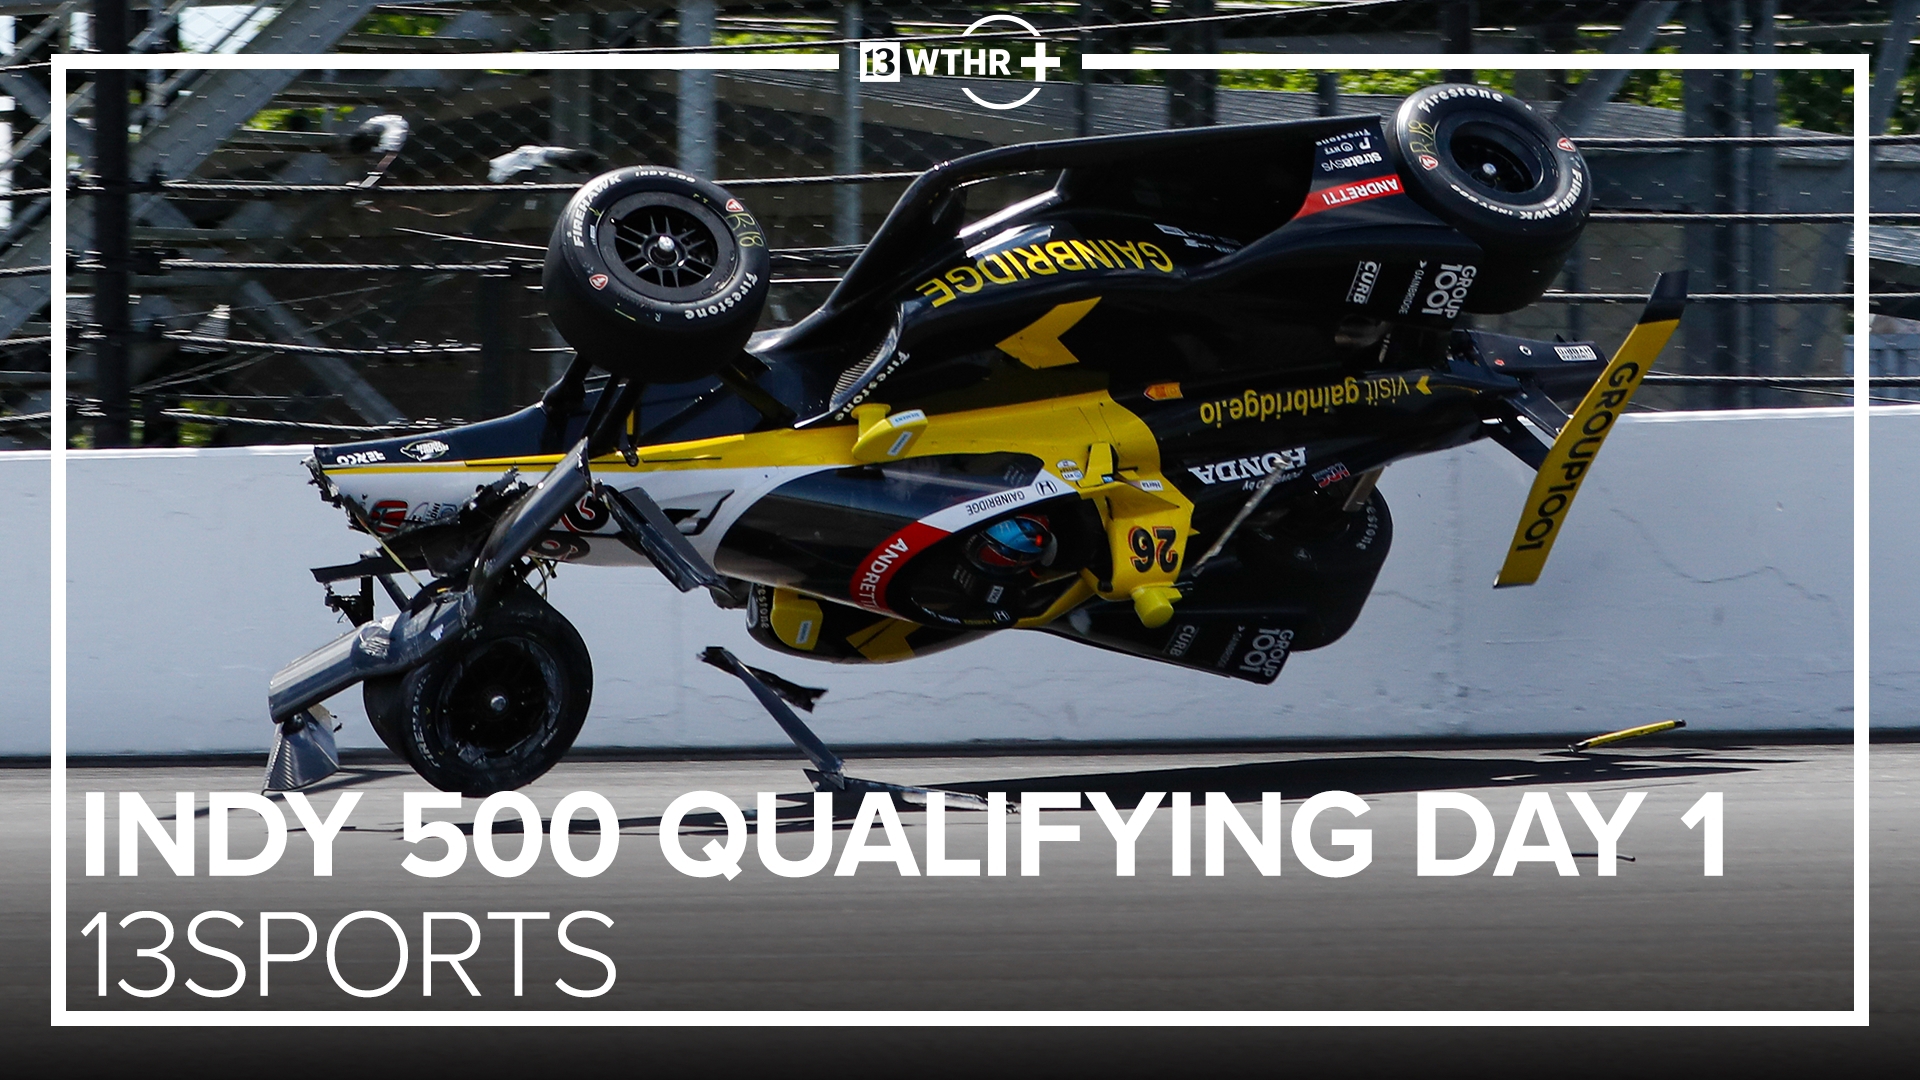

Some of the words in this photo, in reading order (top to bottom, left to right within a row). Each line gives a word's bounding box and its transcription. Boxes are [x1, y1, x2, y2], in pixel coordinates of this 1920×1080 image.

[1417, 86, 1504, 114] Firestone
[572, 173, 622, 248] FIREHAWK
[1321, 178, 1400, 206] ANDRETTI
[1519, 167, 1584, 221] FIREHAWK
[684, 271, 758, 321] Firestone
[915, 238, 1174, 308] GAINBRIDGE
[1353, 260, 1378, 305] CURB
[1421, 262, 1463, 316] 1001
[1444, 264, 1478, 320] GROUP
[1199, 376, 1359, 429] gainbridge.io
[1363, 375, 1410, 406] visit
[1187, 447, 1307, 485] HONDA
[1515, 361, 1640, 553] GROUP1001
[965, 489, 1026, 516] GAINBRIDGE
[1127, 525, 1179, 574] 26
[1169, 624, 1197, 658] CURB
[1238, 627, 1281, 674] 1001
[1262, 628, 1296, 678] GROUP
